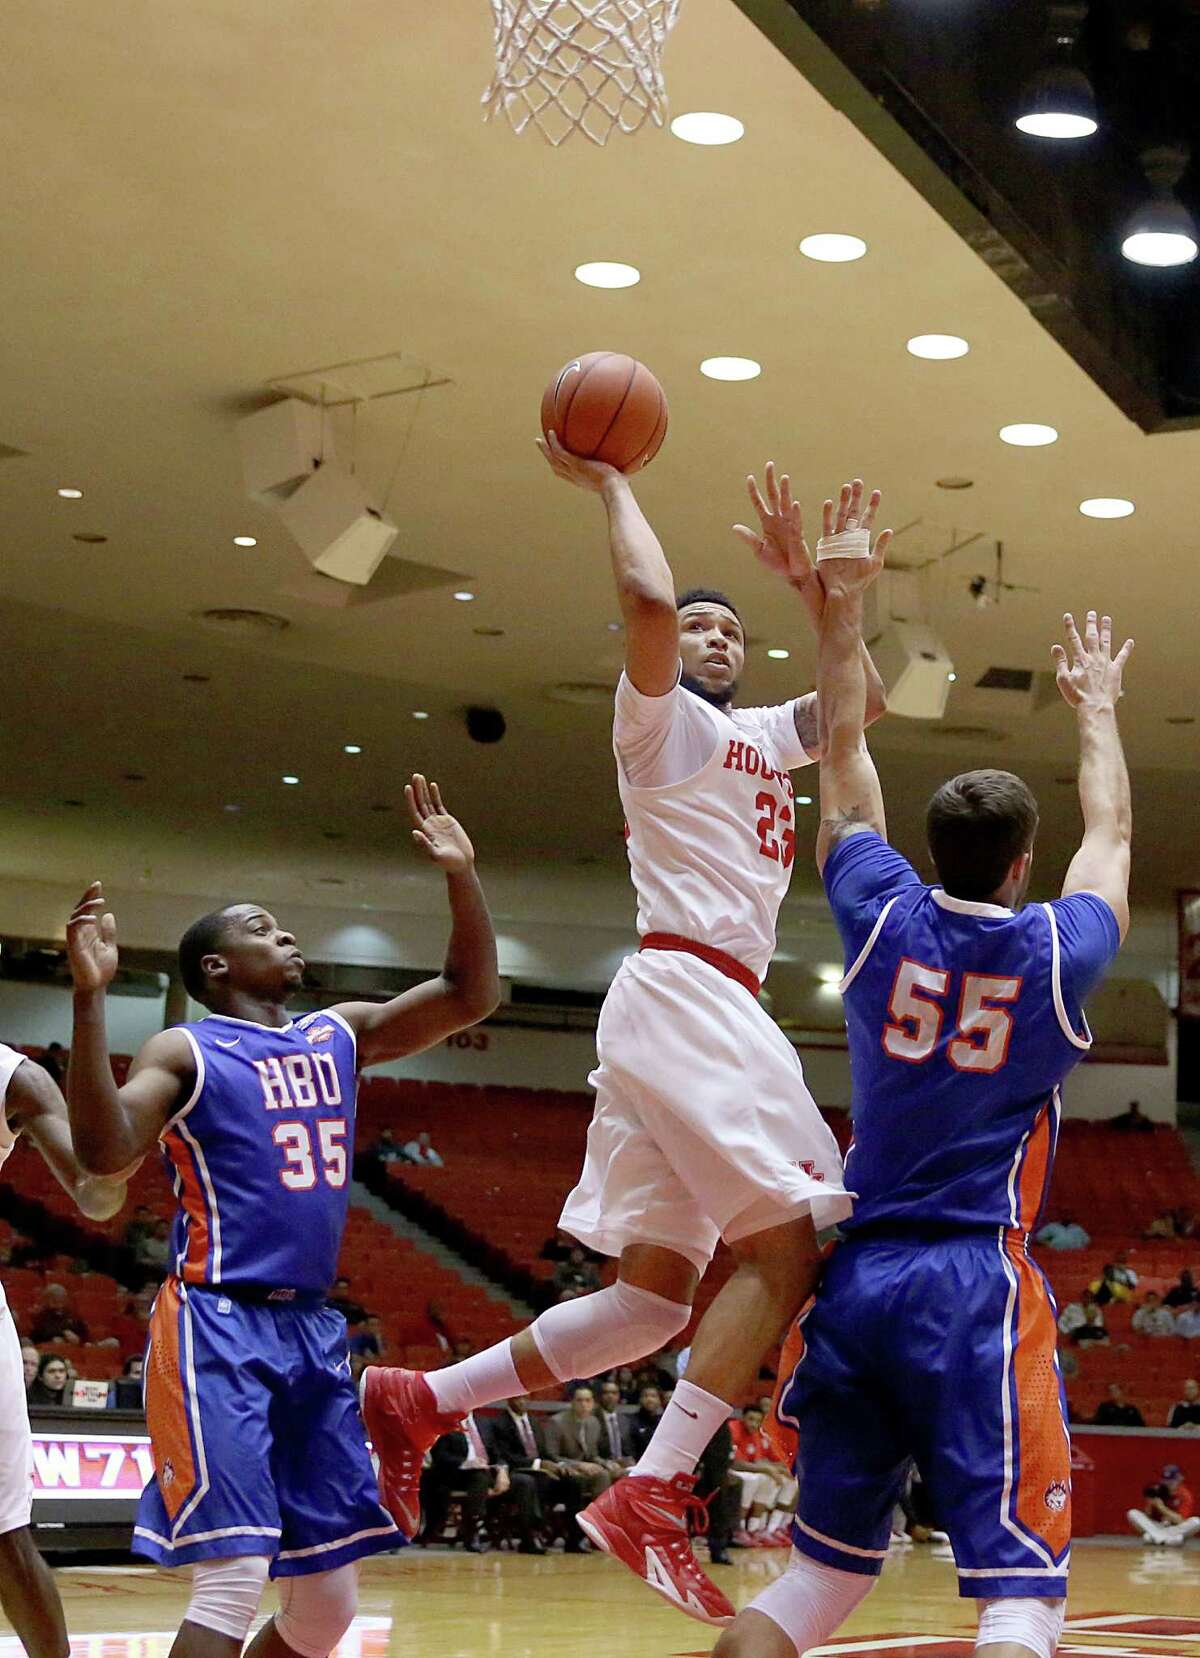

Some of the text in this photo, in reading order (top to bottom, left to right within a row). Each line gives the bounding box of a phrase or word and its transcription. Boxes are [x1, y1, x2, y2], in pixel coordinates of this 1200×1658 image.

[881, 956, 1024, 1075] 55
[253, 1051, 342, 1110] HBU
[272, 1117, 349, 1192] 35
